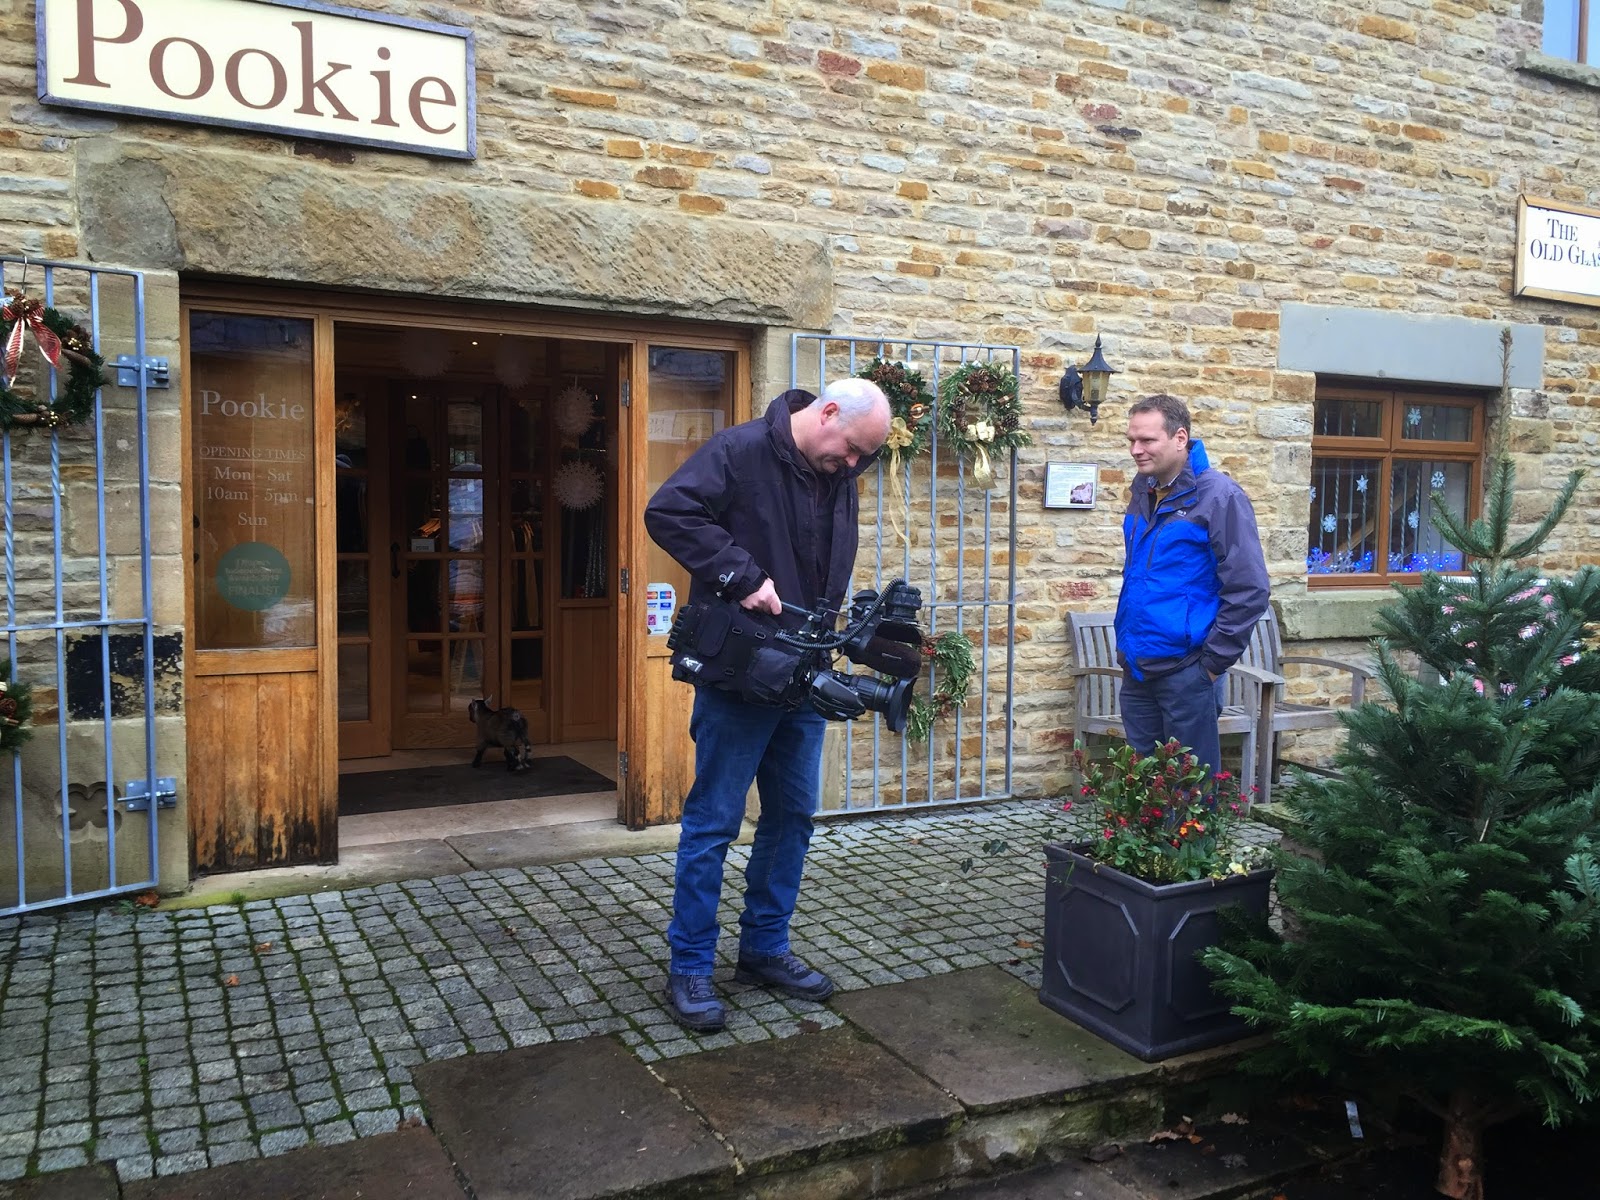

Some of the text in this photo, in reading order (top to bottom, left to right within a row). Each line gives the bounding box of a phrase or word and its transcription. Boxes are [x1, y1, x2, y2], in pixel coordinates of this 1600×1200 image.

[63, 0, 457, 135] Pookie
[1547, 218, 1578, 242] THE
[1530, 238, 1563, 262] OLD
[200, 389, 305, 421] Pookie
[200, 446, 306, 460] OPENING TIMES
[214, 466, 251, 481] Mon
[267, 468, 292, 482] Sat
[207, 487, 249, 501] 10am
[264, 488, 298, 505] 5pm
[238, 512, 267, 526] Sun
